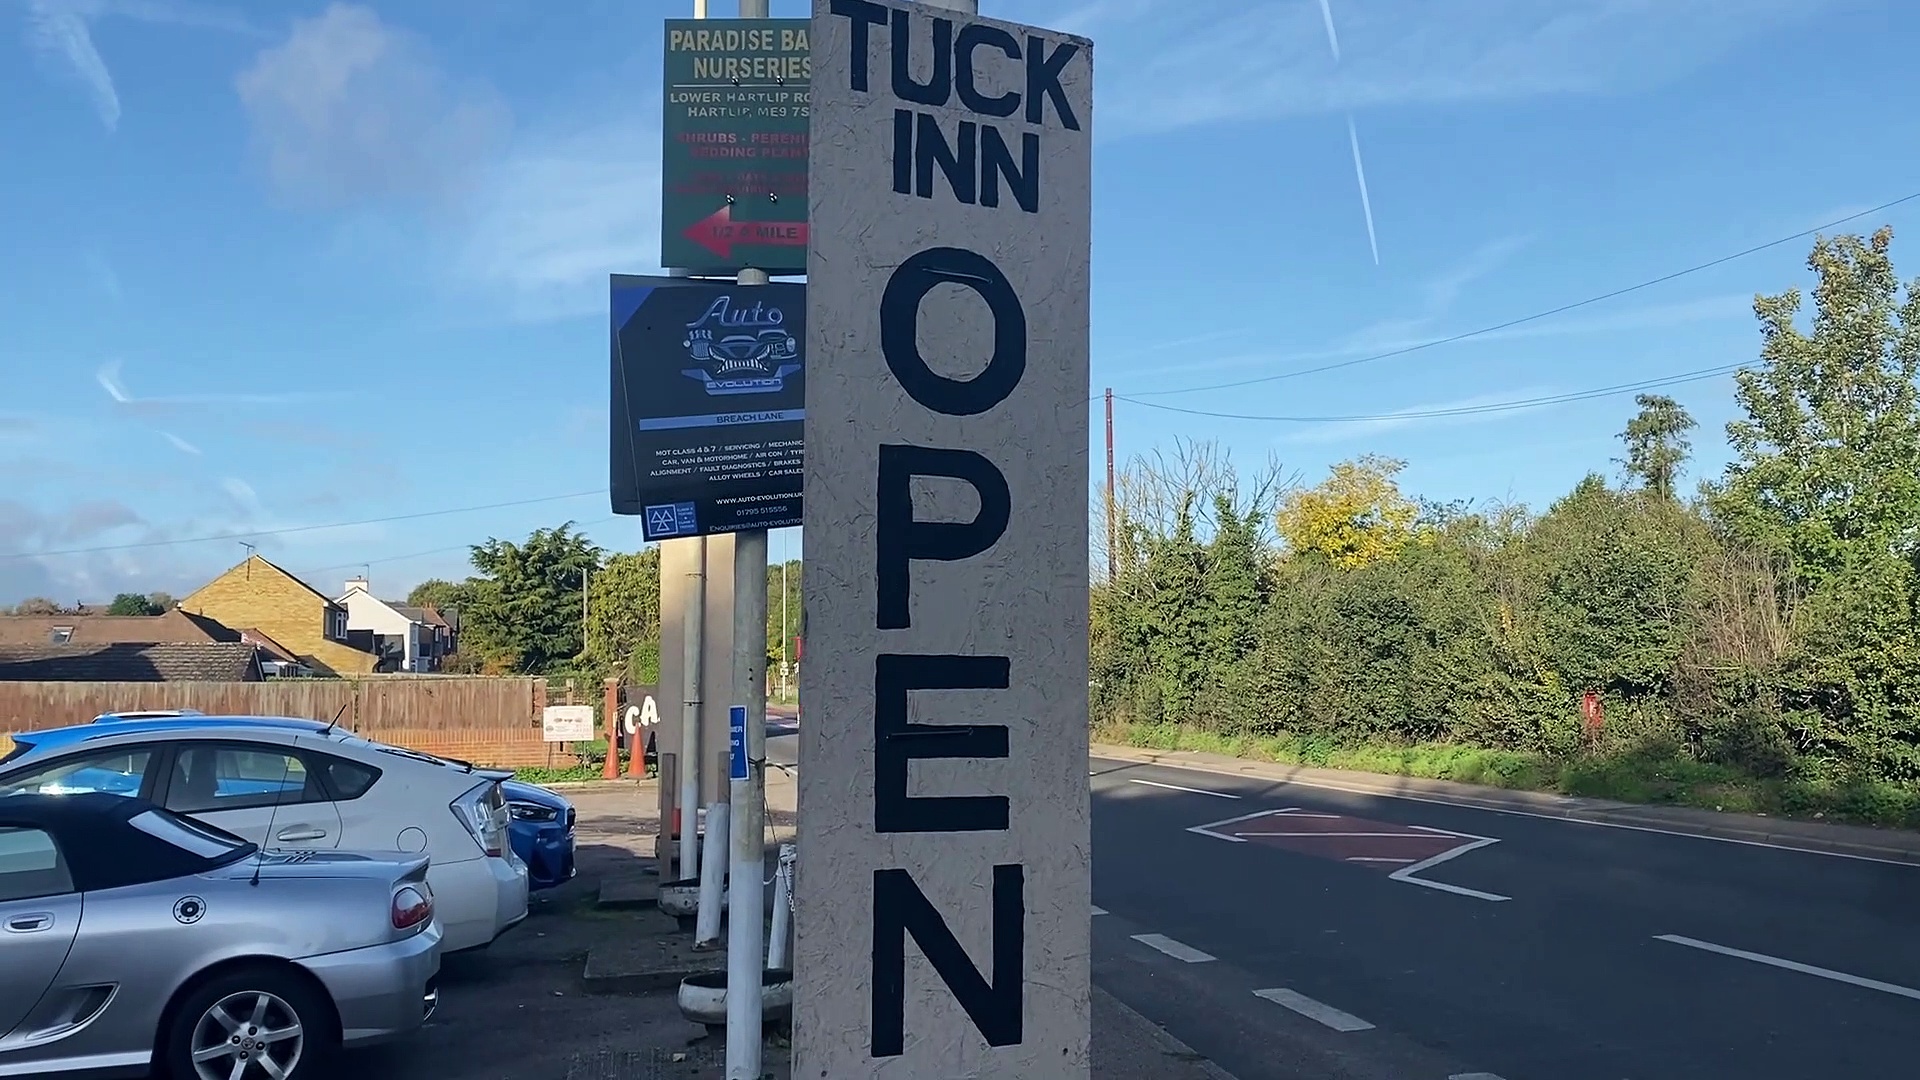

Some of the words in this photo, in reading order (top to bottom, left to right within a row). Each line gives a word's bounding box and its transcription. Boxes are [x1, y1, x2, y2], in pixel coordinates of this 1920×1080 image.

[670, 29, 774, 51] PARADISE
[694, 57, 810, 79] NURSERIES
[830, 0, 1081, 131] TUCK
[670, 92, 721, 103] LOWER
[727, 92, 789, 103] HARTLIP
[688, 106, 752, 118] HARTLIP,
[757, 107, 787, 117] ME9
[893, 109, 1039, 213] INN
[756, 226, 799, 239] MILE
[686, 296, 784, 327] Auto
[717, 413, 754, 424] BREACH
[758, 412, 785, 421] LANE
[724, 443, 760, 451] SERVICING
[768, 440, 804, 448] MECHANIC
[704, 453, 748, 462] MOTORHOME
[650, 467, 692, 476] ALIGNMENT
[721, 462, 767, 471] DIAGNOSTICS
[773, 459, 801, 467] BRAKES
[736, 507, 759, 516] 01795
[709, 518, 803, 532] ENQUIRIES@AUTO-EVOLUTIO
[871, 246, 1026, 1058] OPEN
[625, 695, 660, 734] CA
